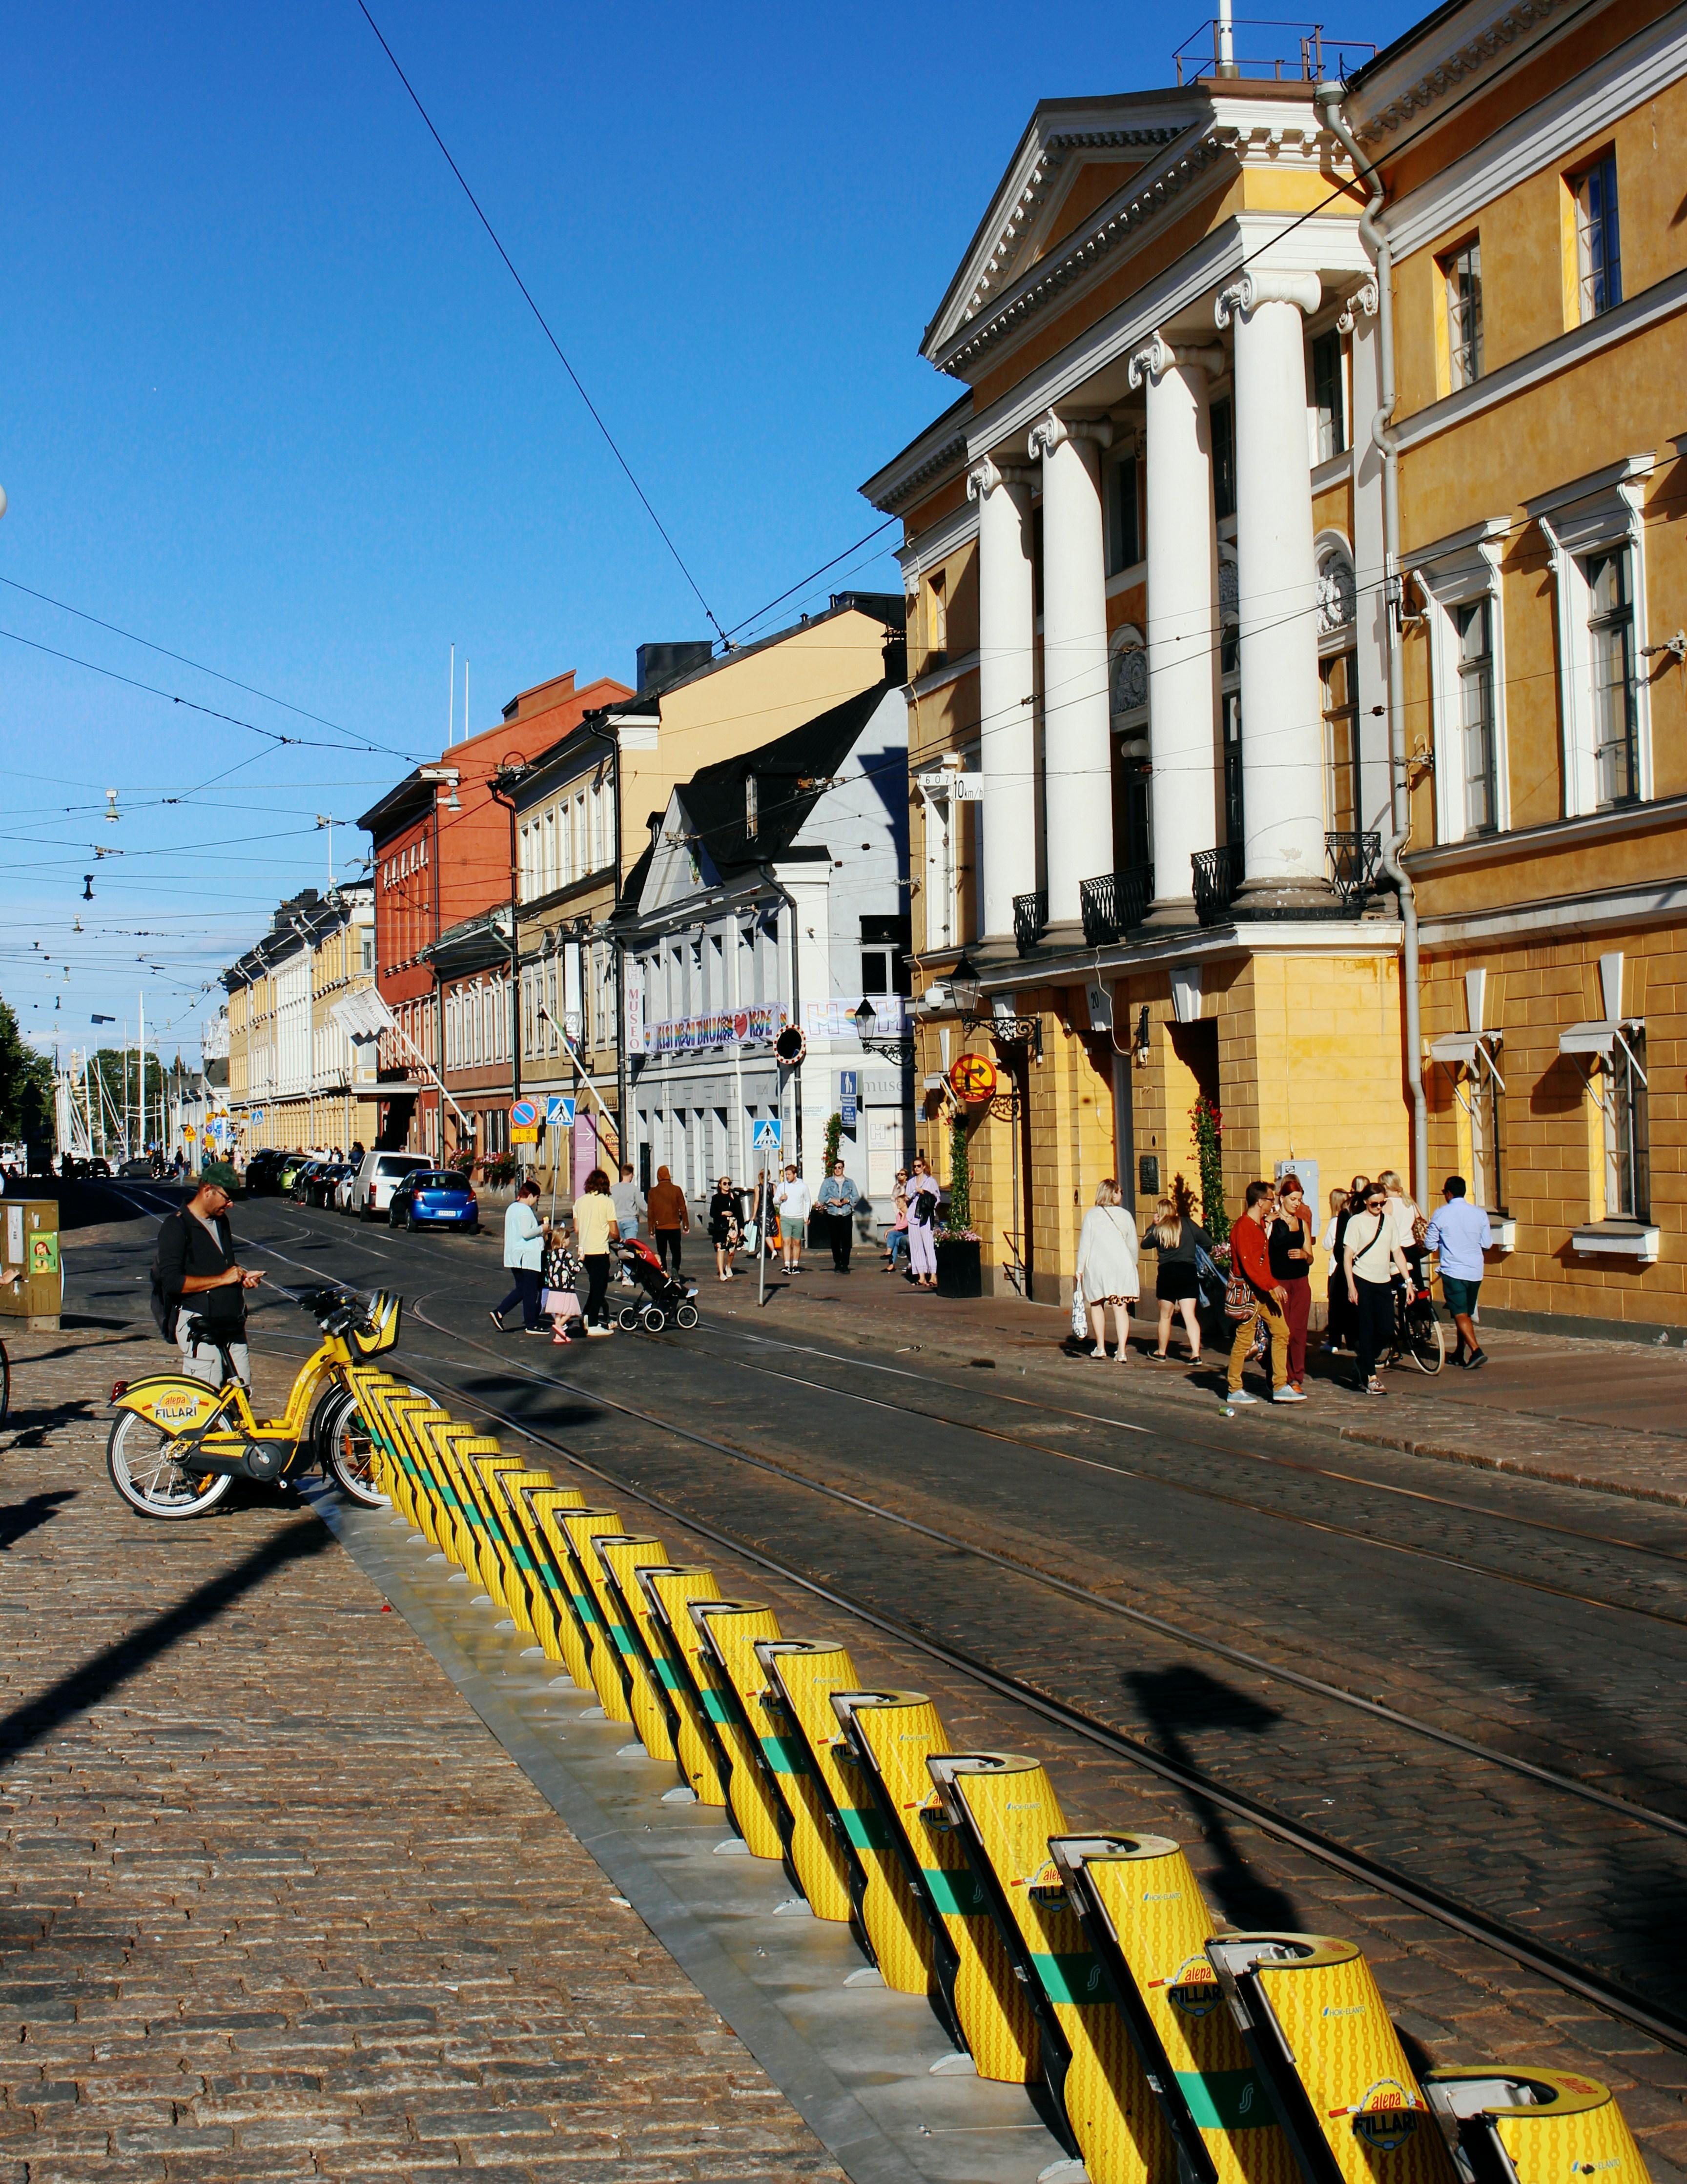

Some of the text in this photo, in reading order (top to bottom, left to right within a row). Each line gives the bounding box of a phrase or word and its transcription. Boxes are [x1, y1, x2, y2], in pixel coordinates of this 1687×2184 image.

[1091, 991, 1099, 1009] 20
[629, 989, 639, 1049] MUSEO
[165, 1396, 185, 1405] alepa
[156, 1407, 197, 1419] FILLARI
[1149, 1892, 1182, 1901] HOK-ELANTO
[1185, 1967, 1211, 1982] alepa
[1329, 2005, 1366, 2017] HOK-ELANTO
[1371, 2092, 1401, 2109] alepa
